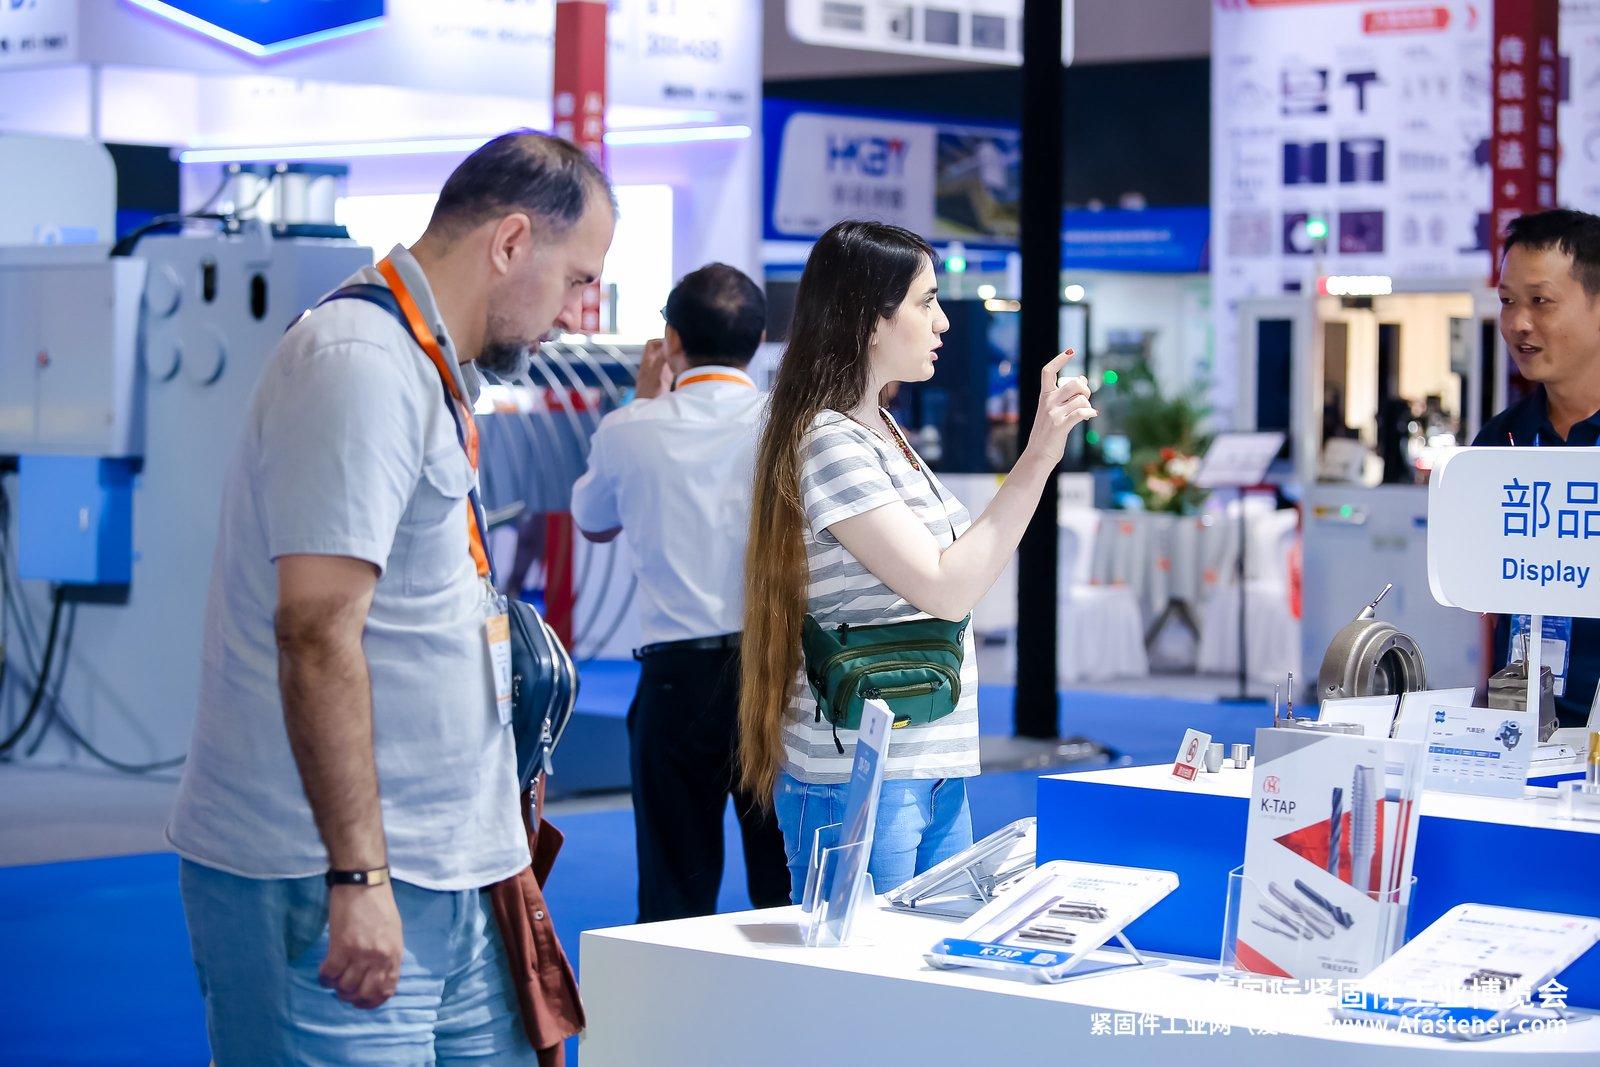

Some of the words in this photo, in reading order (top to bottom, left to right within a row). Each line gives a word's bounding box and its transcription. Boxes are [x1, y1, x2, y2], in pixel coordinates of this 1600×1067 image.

[1501, 477, 1600, 540] 部品
[1502, 557, 1590, 589] Display
[1261, 798, 1297, 815] K-TAP
[979, 947, 1022, 958] K-TAP
